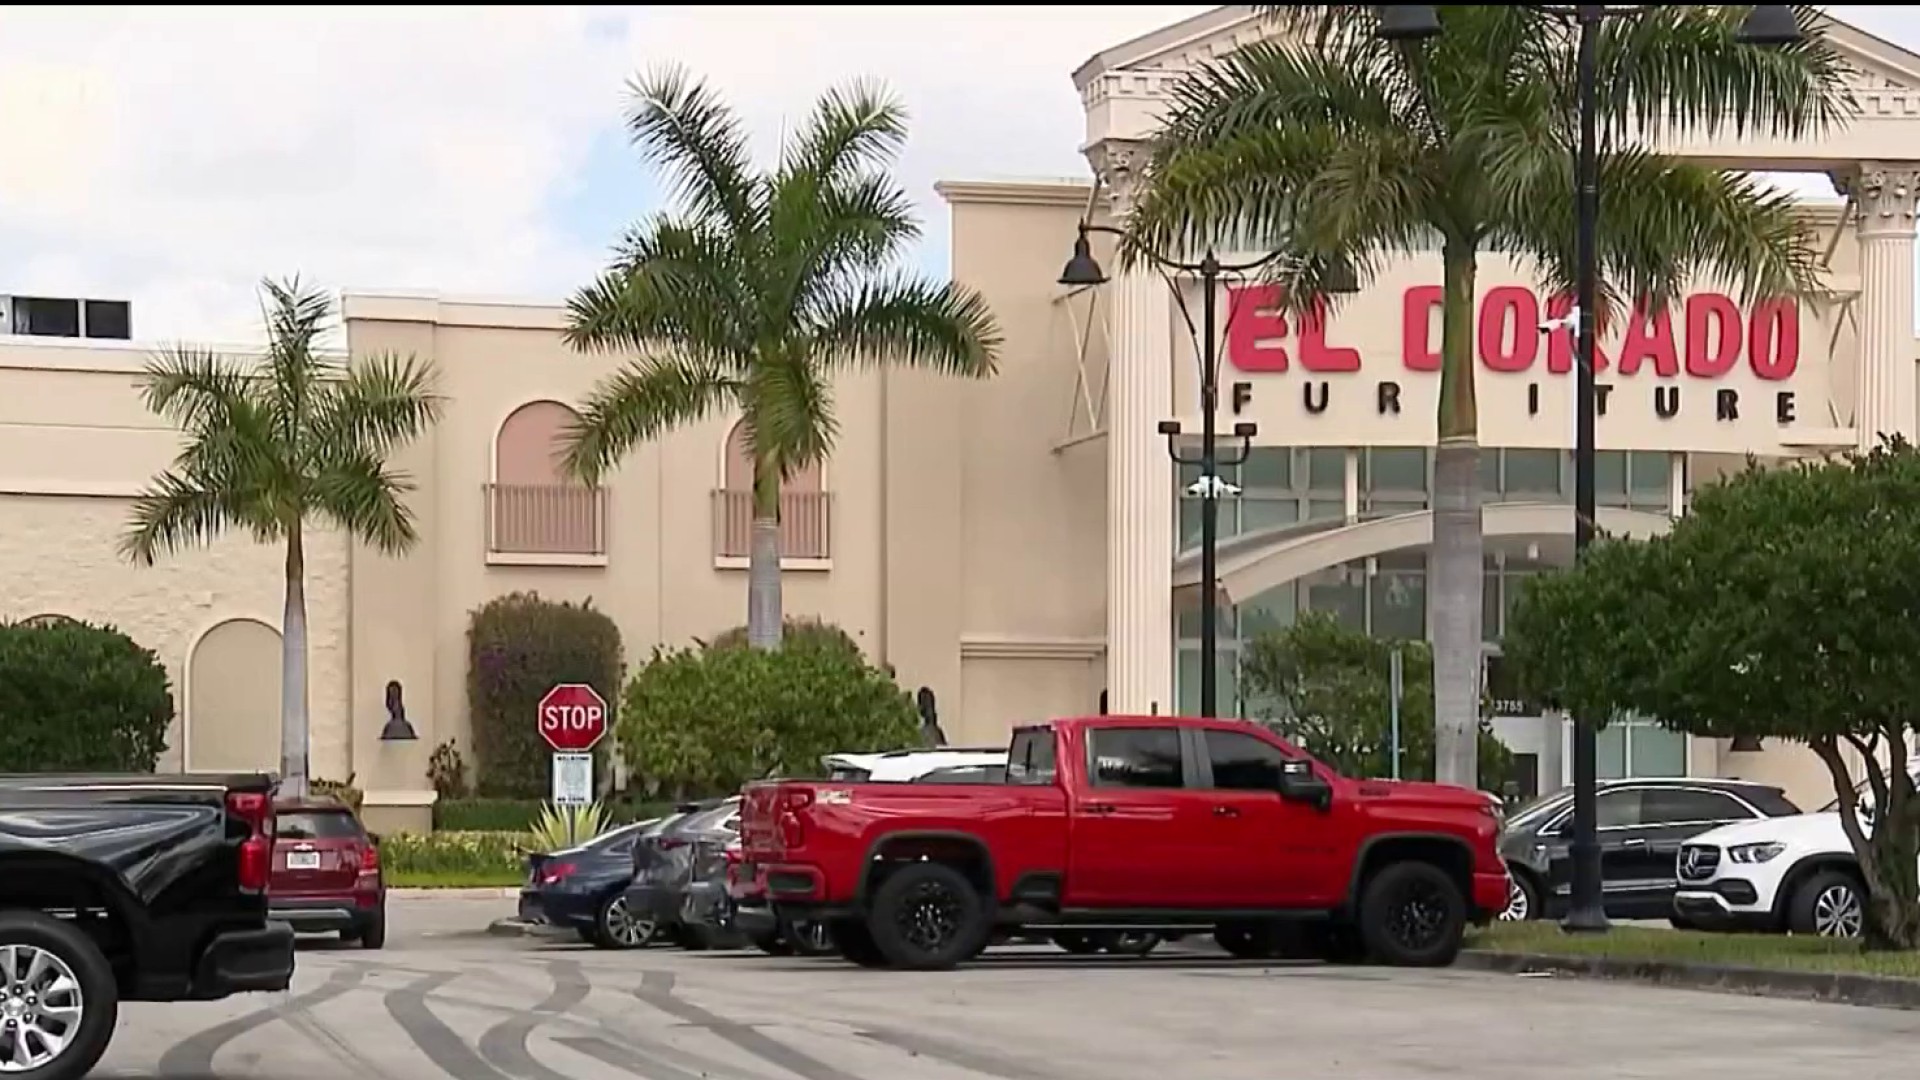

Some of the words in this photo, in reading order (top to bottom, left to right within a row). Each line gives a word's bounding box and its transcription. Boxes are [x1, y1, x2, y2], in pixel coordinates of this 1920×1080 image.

[1229, 284, 1361, 372] EL
[1403, 285, 1799, 380] DORADO
[1233, 381, 1795, 424] FURITURE
[544, 706, 602, 731] STOP
